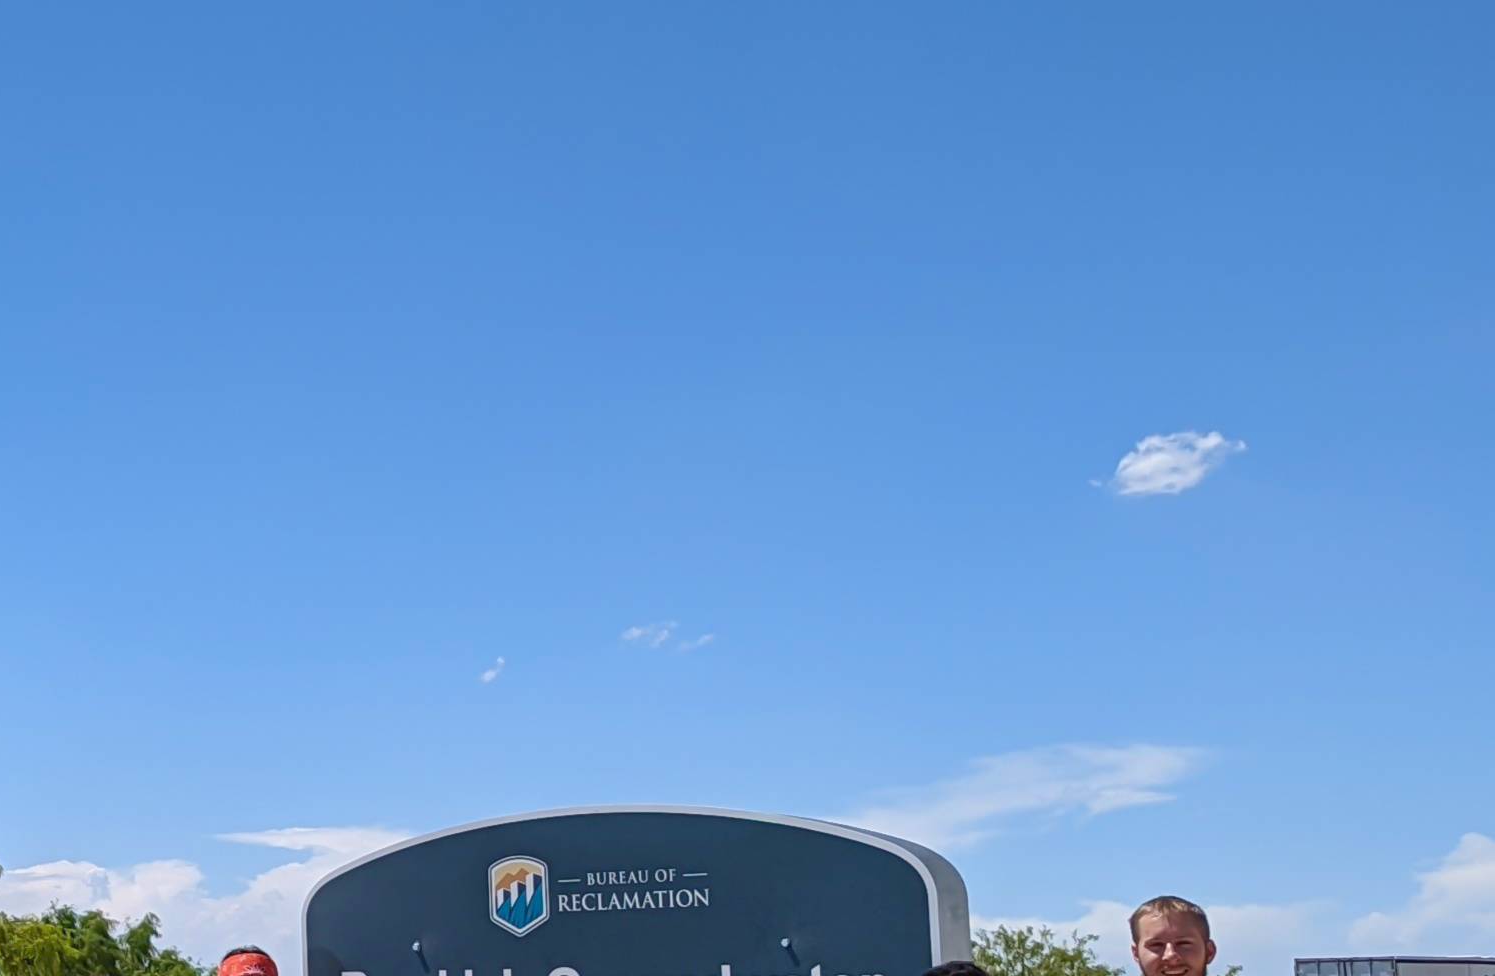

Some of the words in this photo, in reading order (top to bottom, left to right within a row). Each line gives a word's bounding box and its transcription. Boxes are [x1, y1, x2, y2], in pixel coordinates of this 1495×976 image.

[586, 868, 648, 886] BUREAU
[654, 868, 677, 883] OF
[557, 887, 710, 913] RECLAMATION
